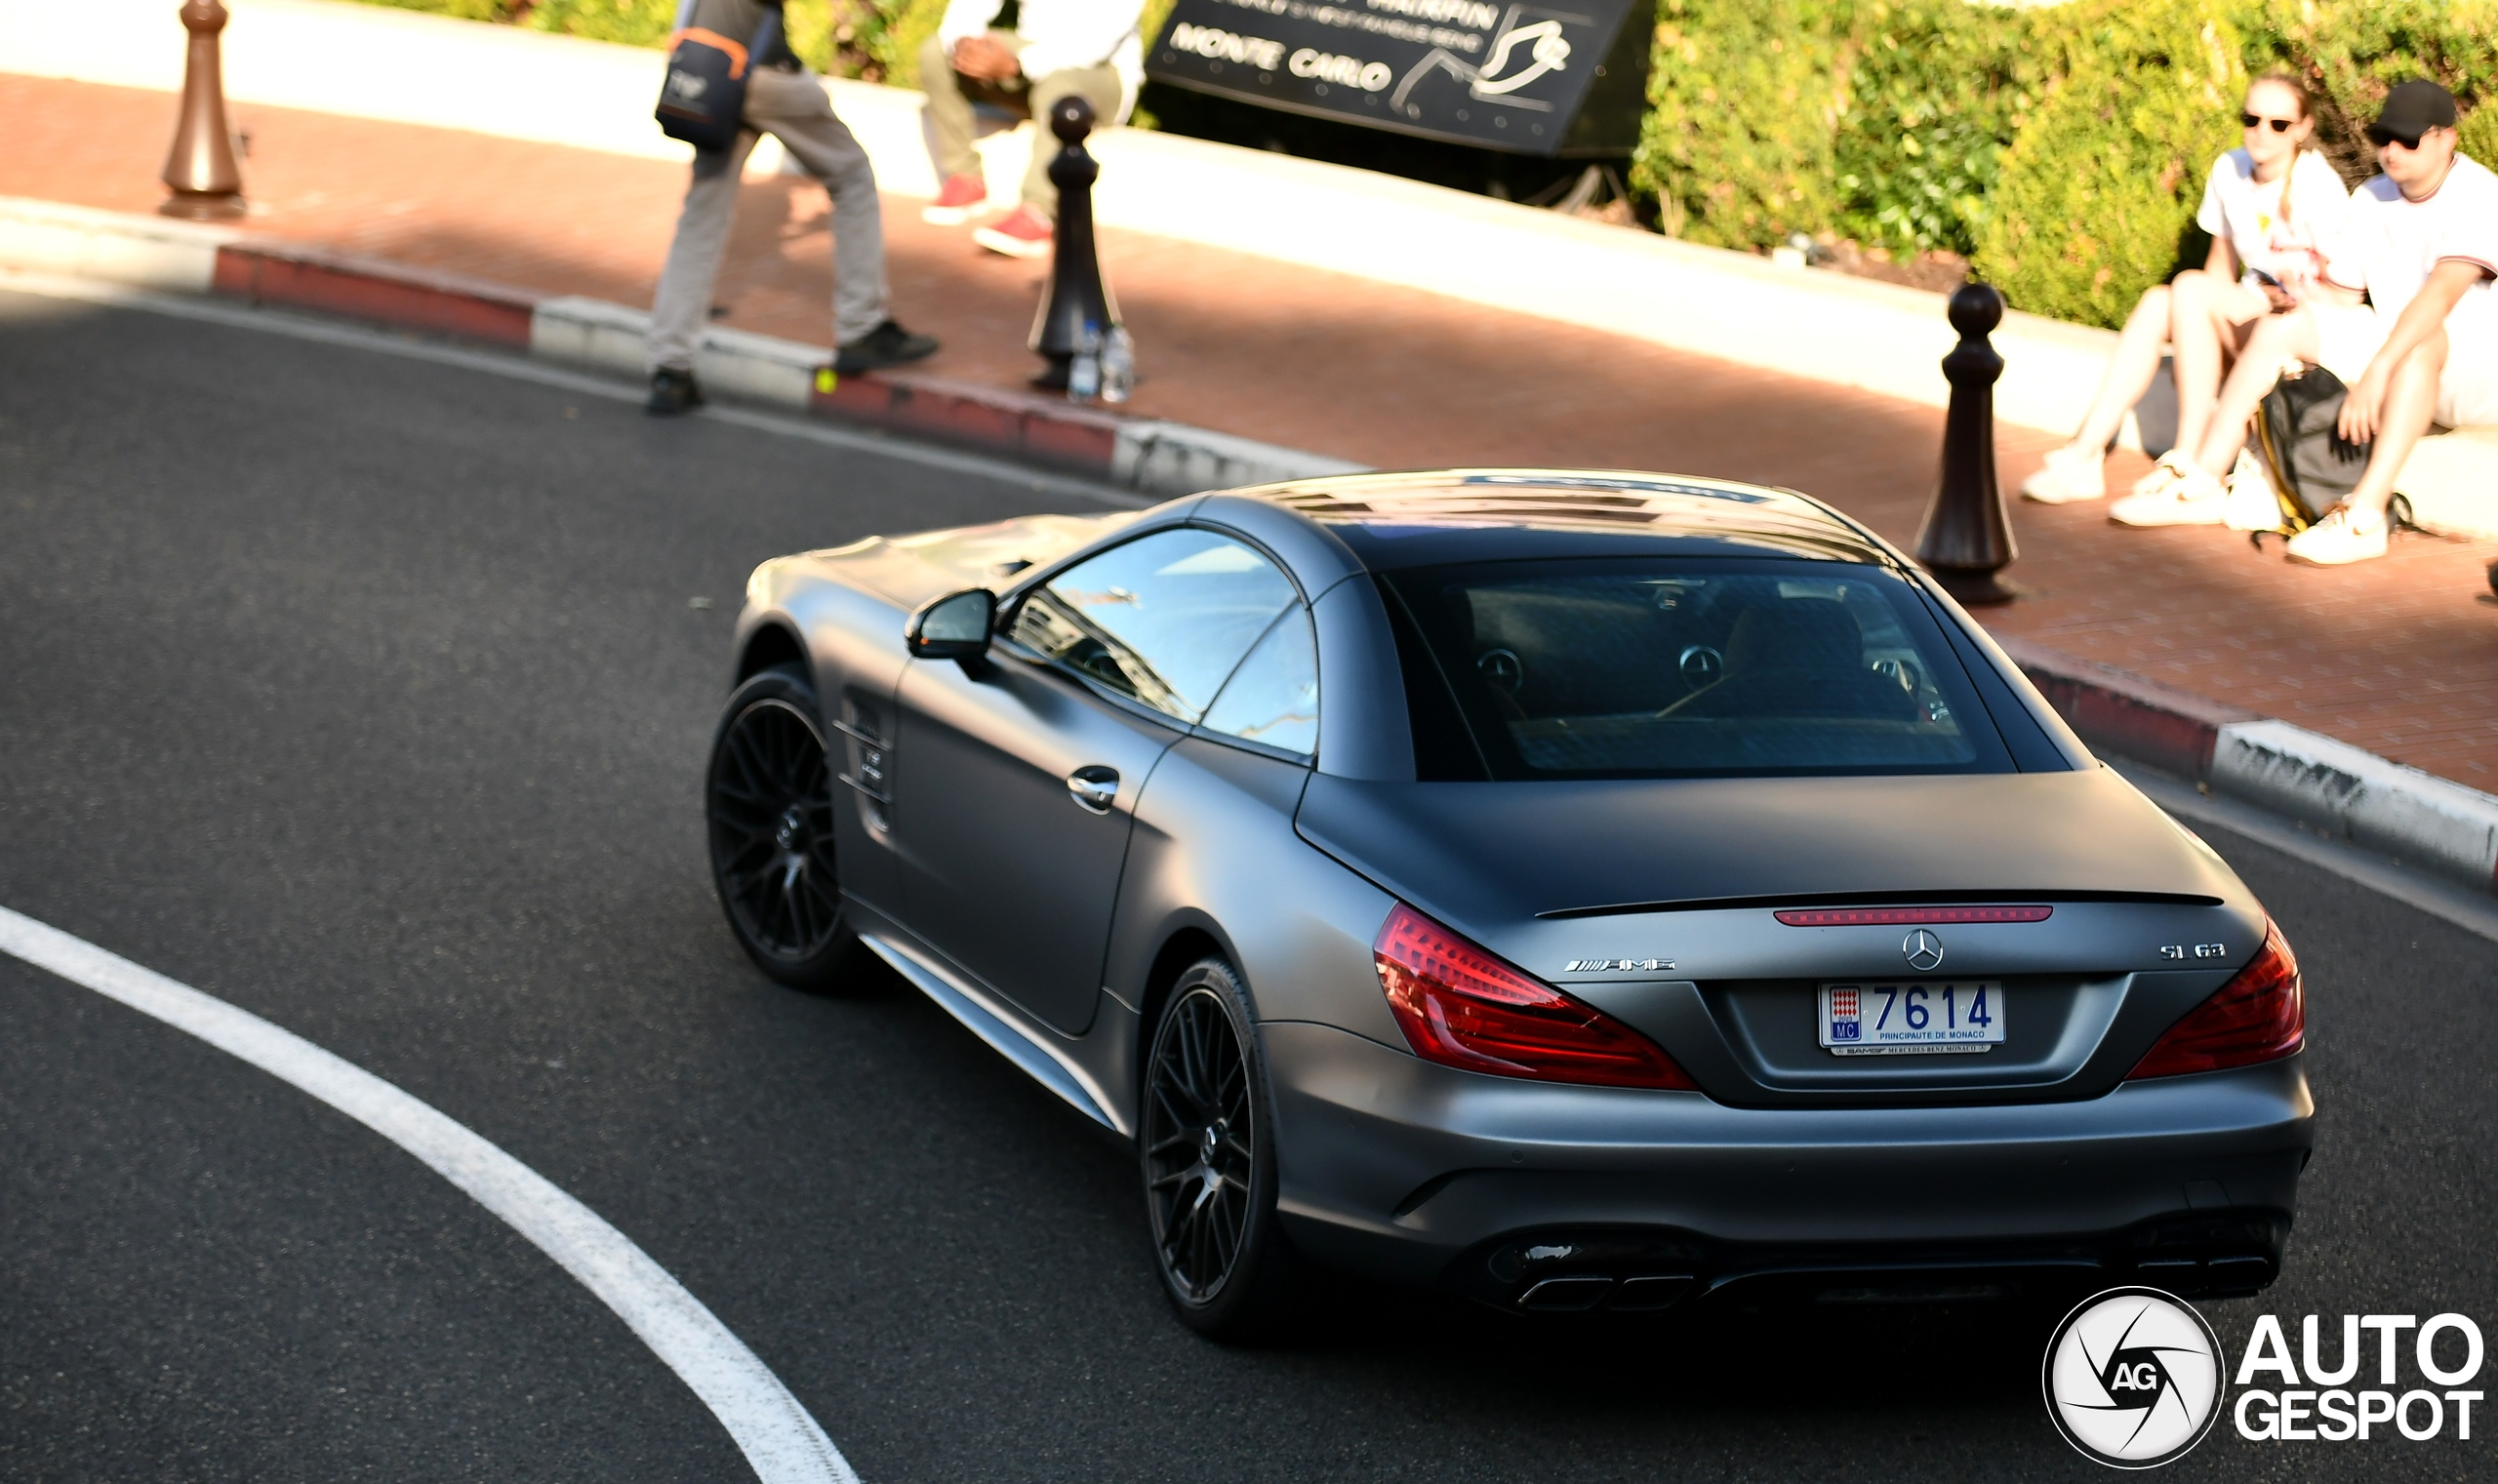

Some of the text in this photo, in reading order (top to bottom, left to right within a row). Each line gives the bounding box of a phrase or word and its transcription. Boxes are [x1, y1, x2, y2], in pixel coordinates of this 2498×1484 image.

[1169, 21, 1392, 92] MONTE CARLO
[2194, 943, 2226, 959] 63
[1598, 958, 1675, 972] AMG
[1874, 984, 1992, 1031] 7614
[1836, 1023, 1855, 1039] MC
[1879, 1030, 1985, 1040] PRINCIPAUTE DE MONACO
